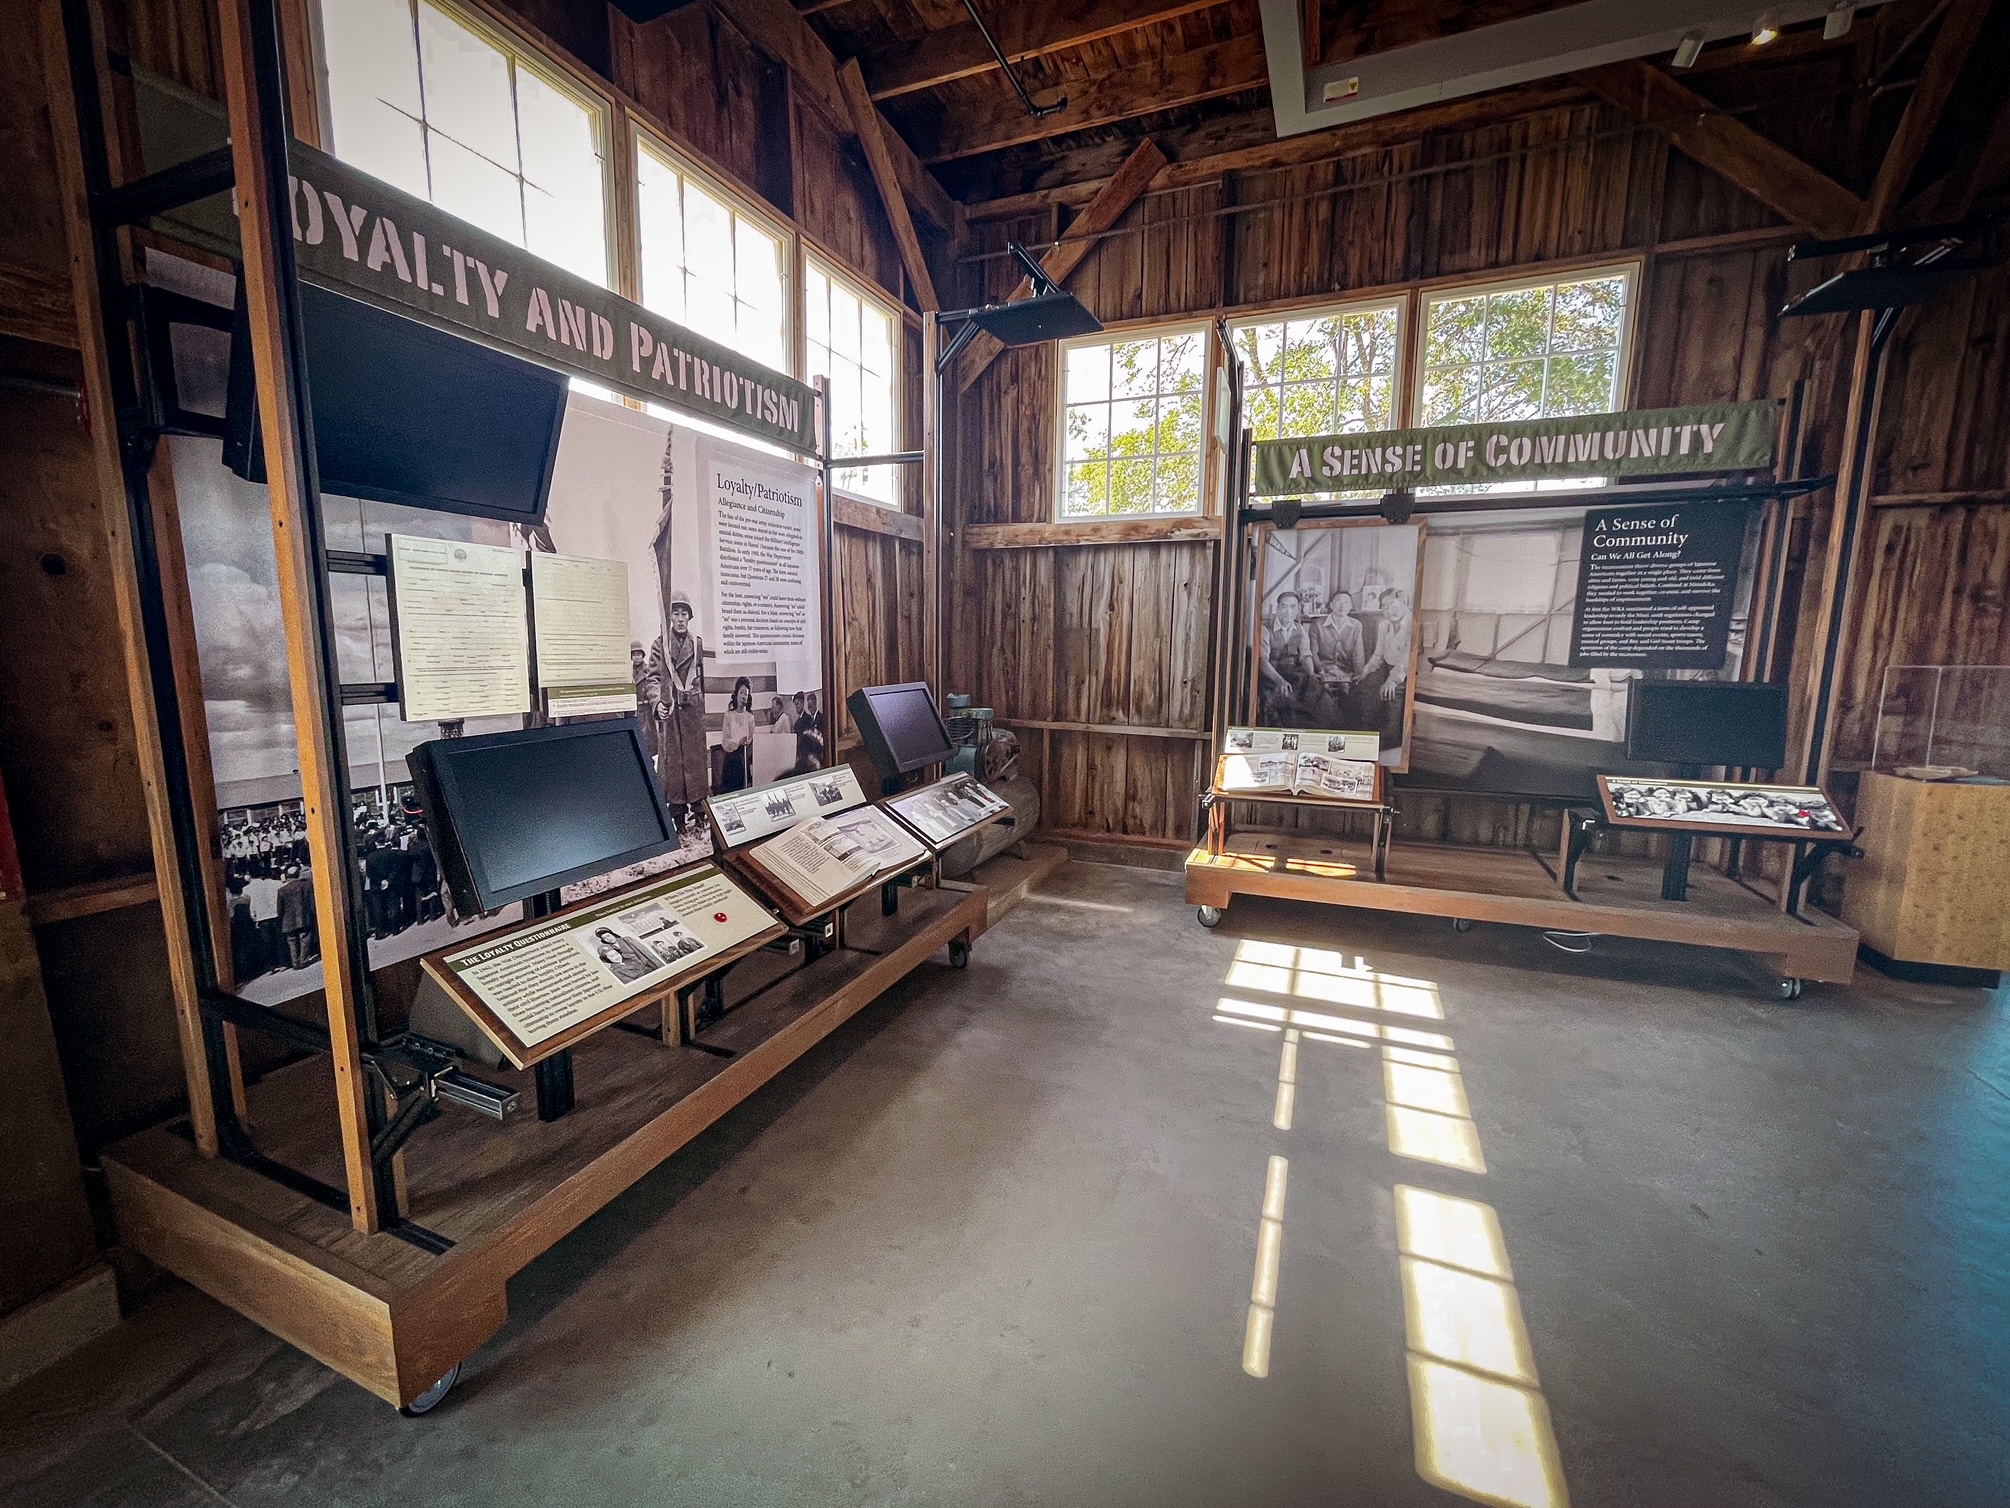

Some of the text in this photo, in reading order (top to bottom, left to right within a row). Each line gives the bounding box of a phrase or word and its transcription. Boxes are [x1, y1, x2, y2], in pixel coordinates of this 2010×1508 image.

[232, 176, 800, 434] OYALTY AND PATRIOTISM
[1289, 422, 1725, 479] A SENSE OF COMMUNITY
[717, 473, 803, 507] Loyalty/Patriotism
[718, 497, 786, 519] Allegiance and Citizenship
[1595, 514, 1680, 532] A Sense of
[1592, 532, 1689, 548] Community
[1591, 550, 1681, 561] Can We All Get Along?
[459, 923, 571, 967] THE LOYALTY QUESTIONNAIRE
